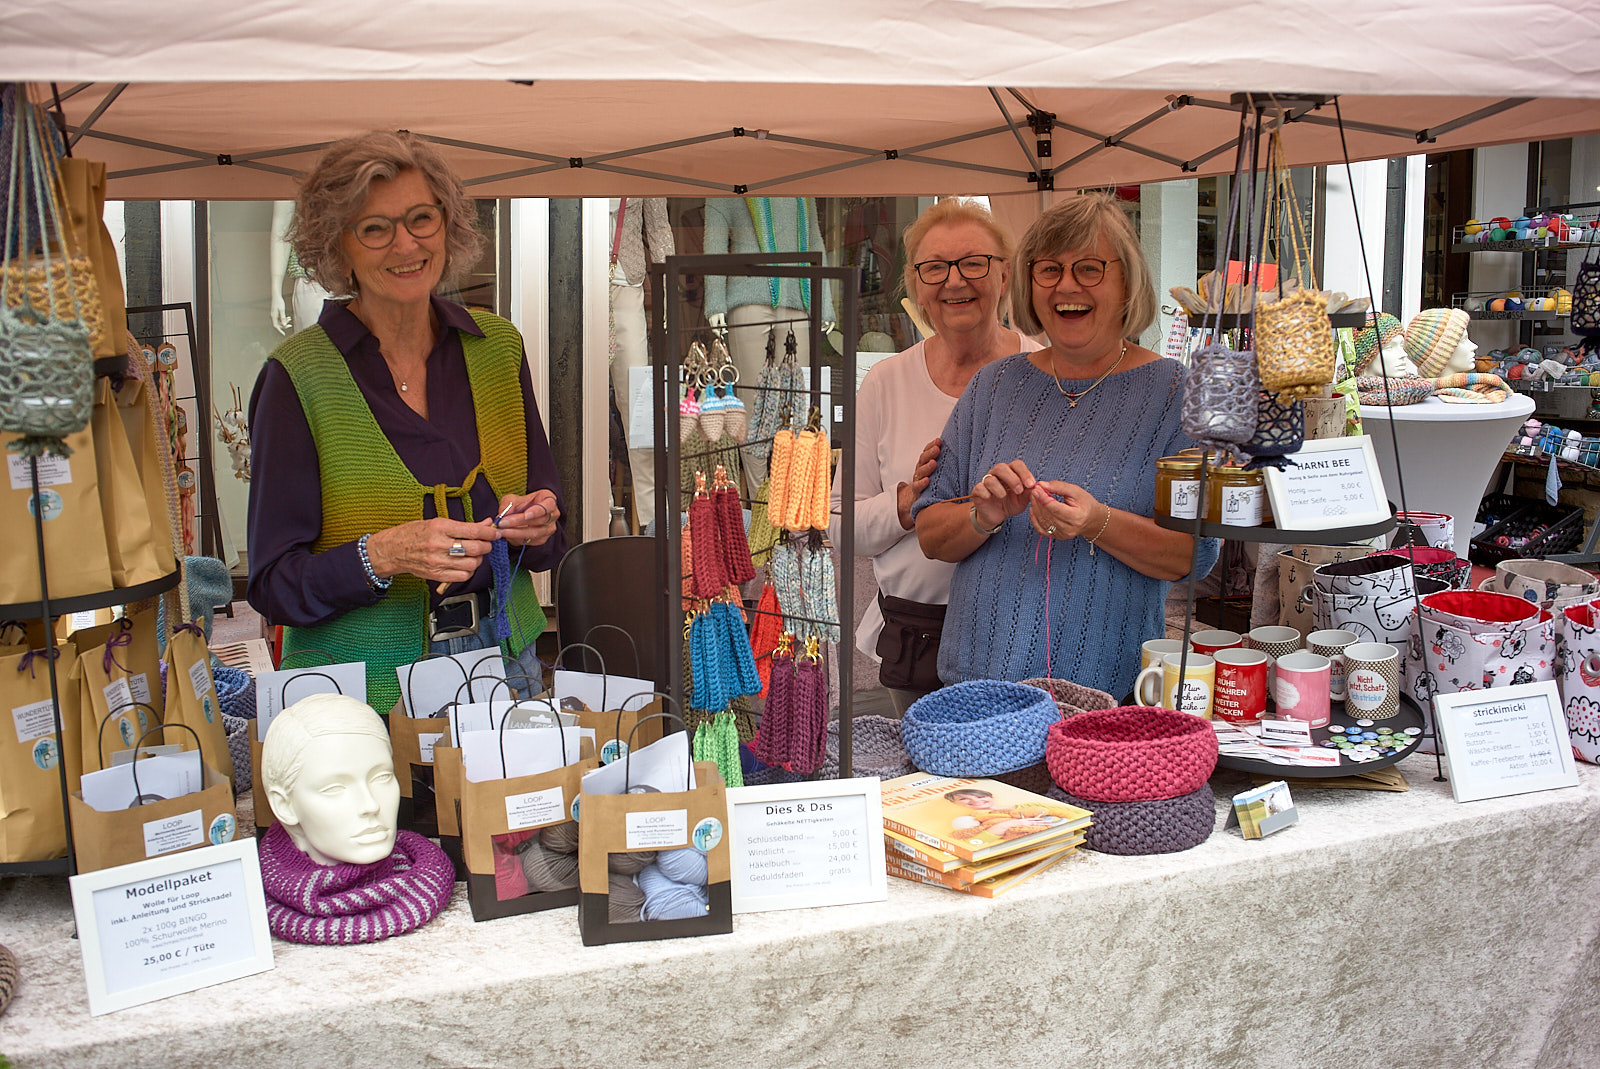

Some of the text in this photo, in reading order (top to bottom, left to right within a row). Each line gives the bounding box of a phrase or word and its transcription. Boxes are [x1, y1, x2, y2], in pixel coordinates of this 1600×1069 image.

[1480, 241, 1497, 250] LANA
[1479, 311, 1495, 320] LANA
[1298, 459, 1350, 470] HARNI BEE
[1290, 498, 1308, 506] Imker
[1218, 678, 1236, 687] RUHE
[1357, 675, 1373, 683] Nicht
[1174, 693, 1191, 701] nch
[1352, 692, 1381, 702] ich stricke
[1215, 698, 1239, 708] WEITER
[16, 704, 53, 720] WUNDERTÜT
[1473, 703, 1526, 717] strickimicki
[1464, 730, 1492, 738] Postkarte
[1510, 762, 1528, 770] Aktion
[524, 796, 543, 804] LOOP
[766, 802, 833, 815] Dies & Das
[163, 820, 183, 829] LOOP
[832, 829, 850, 838] 5,00
[749, 848, 784, 856] Windlicht
[828, 842, 850, 851] 15,00
[828, 854, 851, 863] 24,00
[750, 866, 851, 882] Geduldsfaden gratis
[126, 871, 213, 899] Modellpaket
[143, 891, 200, 909] Wolle für Loop
[111, 892, 232, 926] inkl. Anleitung und Stricknadel
[142, 912, 207, 934] 2x 100g BINGO
[125, 917, 227, 949] 100% Schurwolle Merino
[144, 953, 172, 966] 25,00
[194, 941, 215, 953] Tüte
